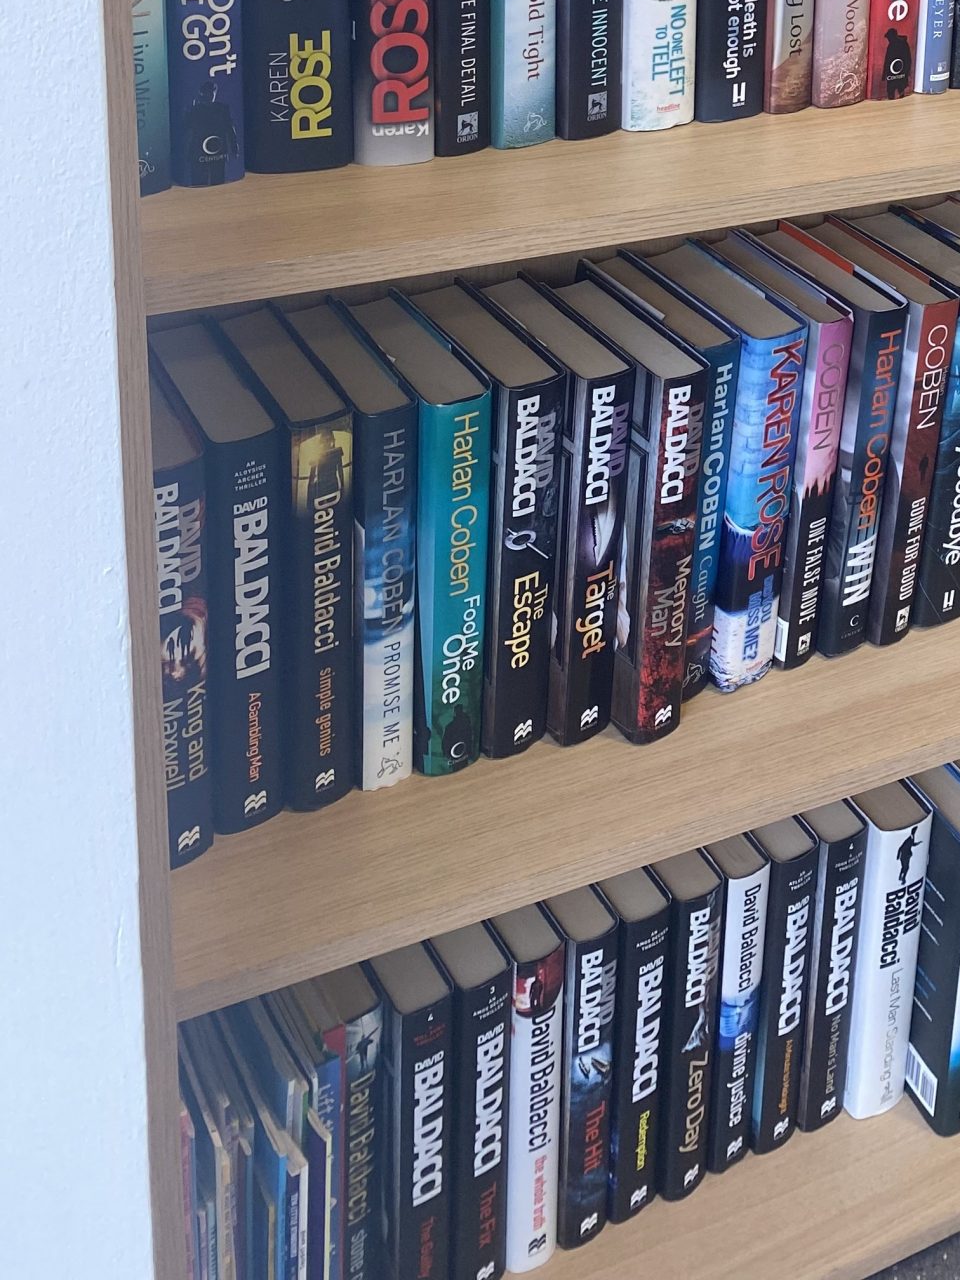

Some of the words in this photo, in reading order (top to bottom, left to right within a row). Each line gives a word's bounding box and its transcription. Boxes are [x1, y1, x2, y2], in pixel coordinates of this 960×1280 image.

[182, 15, 211, 60] Go
[460, 13, 477, 54] FINAL
[522, 26, 545, 82] Tight
[723, 18, 741, 79] enough
[743, 43, 757, 58] is
[268, 51, 289, 122] KAREN
[288, 30, 332, 140] ROSE
[460, 58, 477, 107] DETAIL
[656, 103, 681, 112] headline
[457, 133, 479, 143] ORION
[761, 338, 805, 469] KAREN
[916, 324, 948, 430] COBEN
[452, 411, 480, 502] Harlan
[233, 496, 268, 515] DAVID
[314, 490, 342, 556] David
[747, 469, 790, 581] ROSE
[450, 505, 478, 597] Coben
[842, 533, 878, 607] WIN
[233, 509, 271, 680] BALDACCI
[314, 556, 342, 654] Baldacci
[504, 571, 540, 669] Escape
[575, 560, 614, 659] Target
[315, 667, 336, 711] simple
[383, 641, 401, 718] PROMISE
[442, 634, 468, 704] Once
[315, 713, 336, 757] genius
[383, 722, 401, 748] ME
[879, 886, 906, 969] Baldacci
[902, 876, 924, 935] David
[477, 1022, 505, 1045] DAVID
[578, 949, 604, 1053] BALDACCI
[530, 1004, 557, 1069] David
[732, 1031, 752, 1079] divine
[474, 1033, 504, 1178] BALDACCI
[528, 1063, 554, 1153] Baldacci
[686, 1050, 709, 1111] Zero
[727, 1075, 749, 1128] justice
[636, 1110, 650, 1171] Redemption
[679, 1105, 705, 1153] Day
